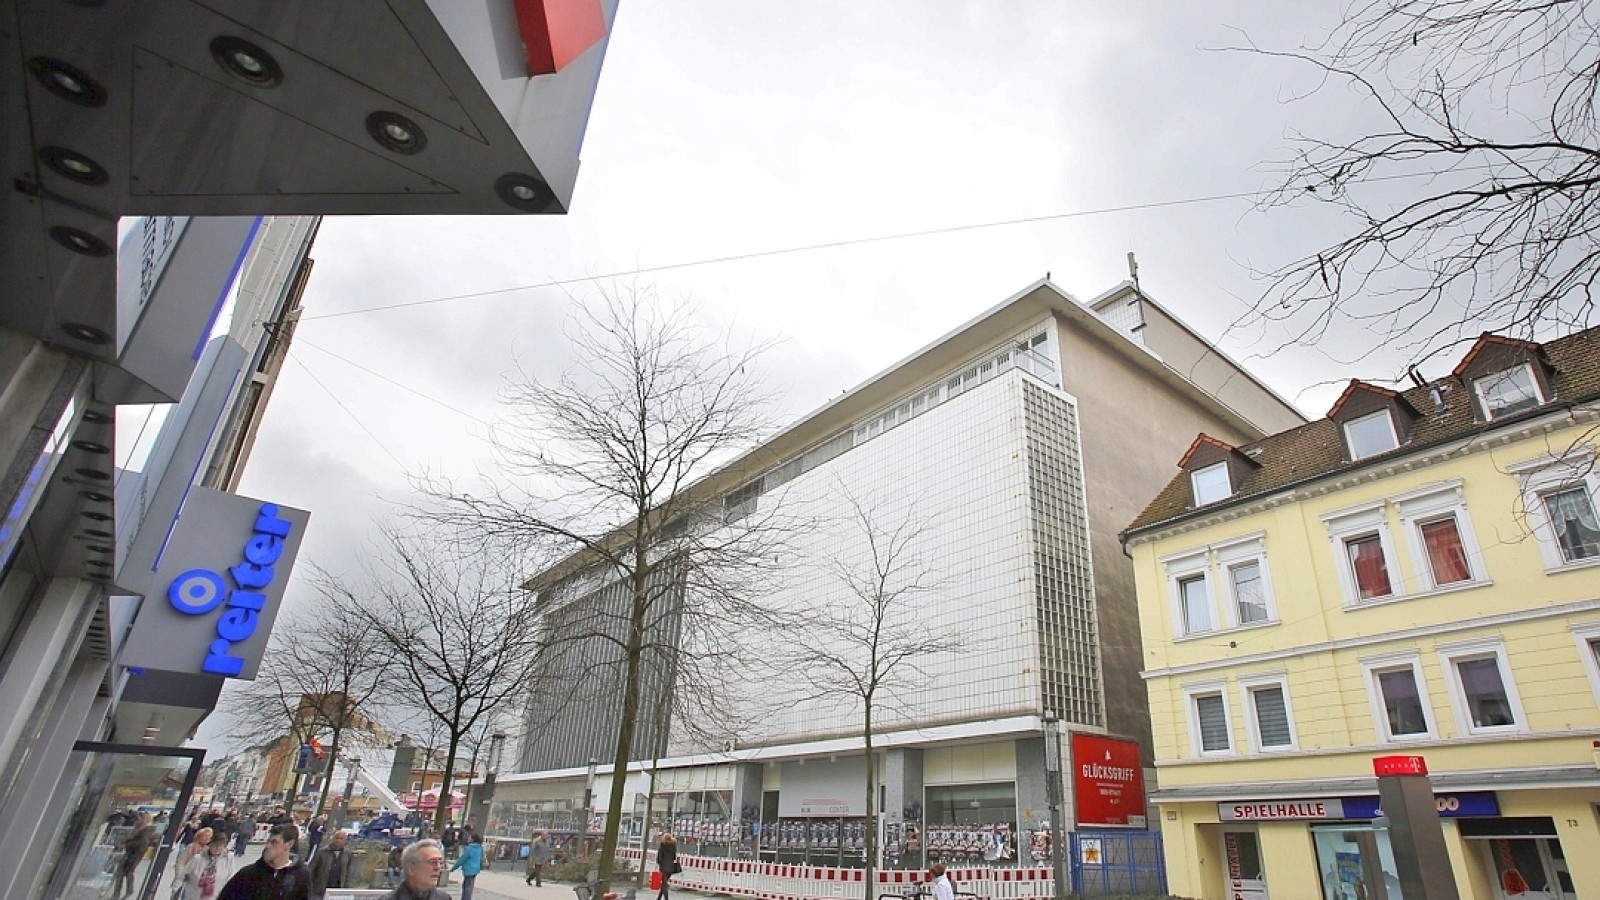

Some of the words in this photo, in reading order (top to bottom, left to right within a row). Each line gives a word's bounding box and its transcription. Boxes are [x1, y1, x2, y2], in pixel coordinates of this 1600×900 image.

[202, 502, 292, 676] reiter
[1082, 763, 1134, 782] GLÜCKSGRIFF
[1233, 802, 1325, 819] SPIELHALLE
[1226, 832, 1244, 900] PIELHALLE
